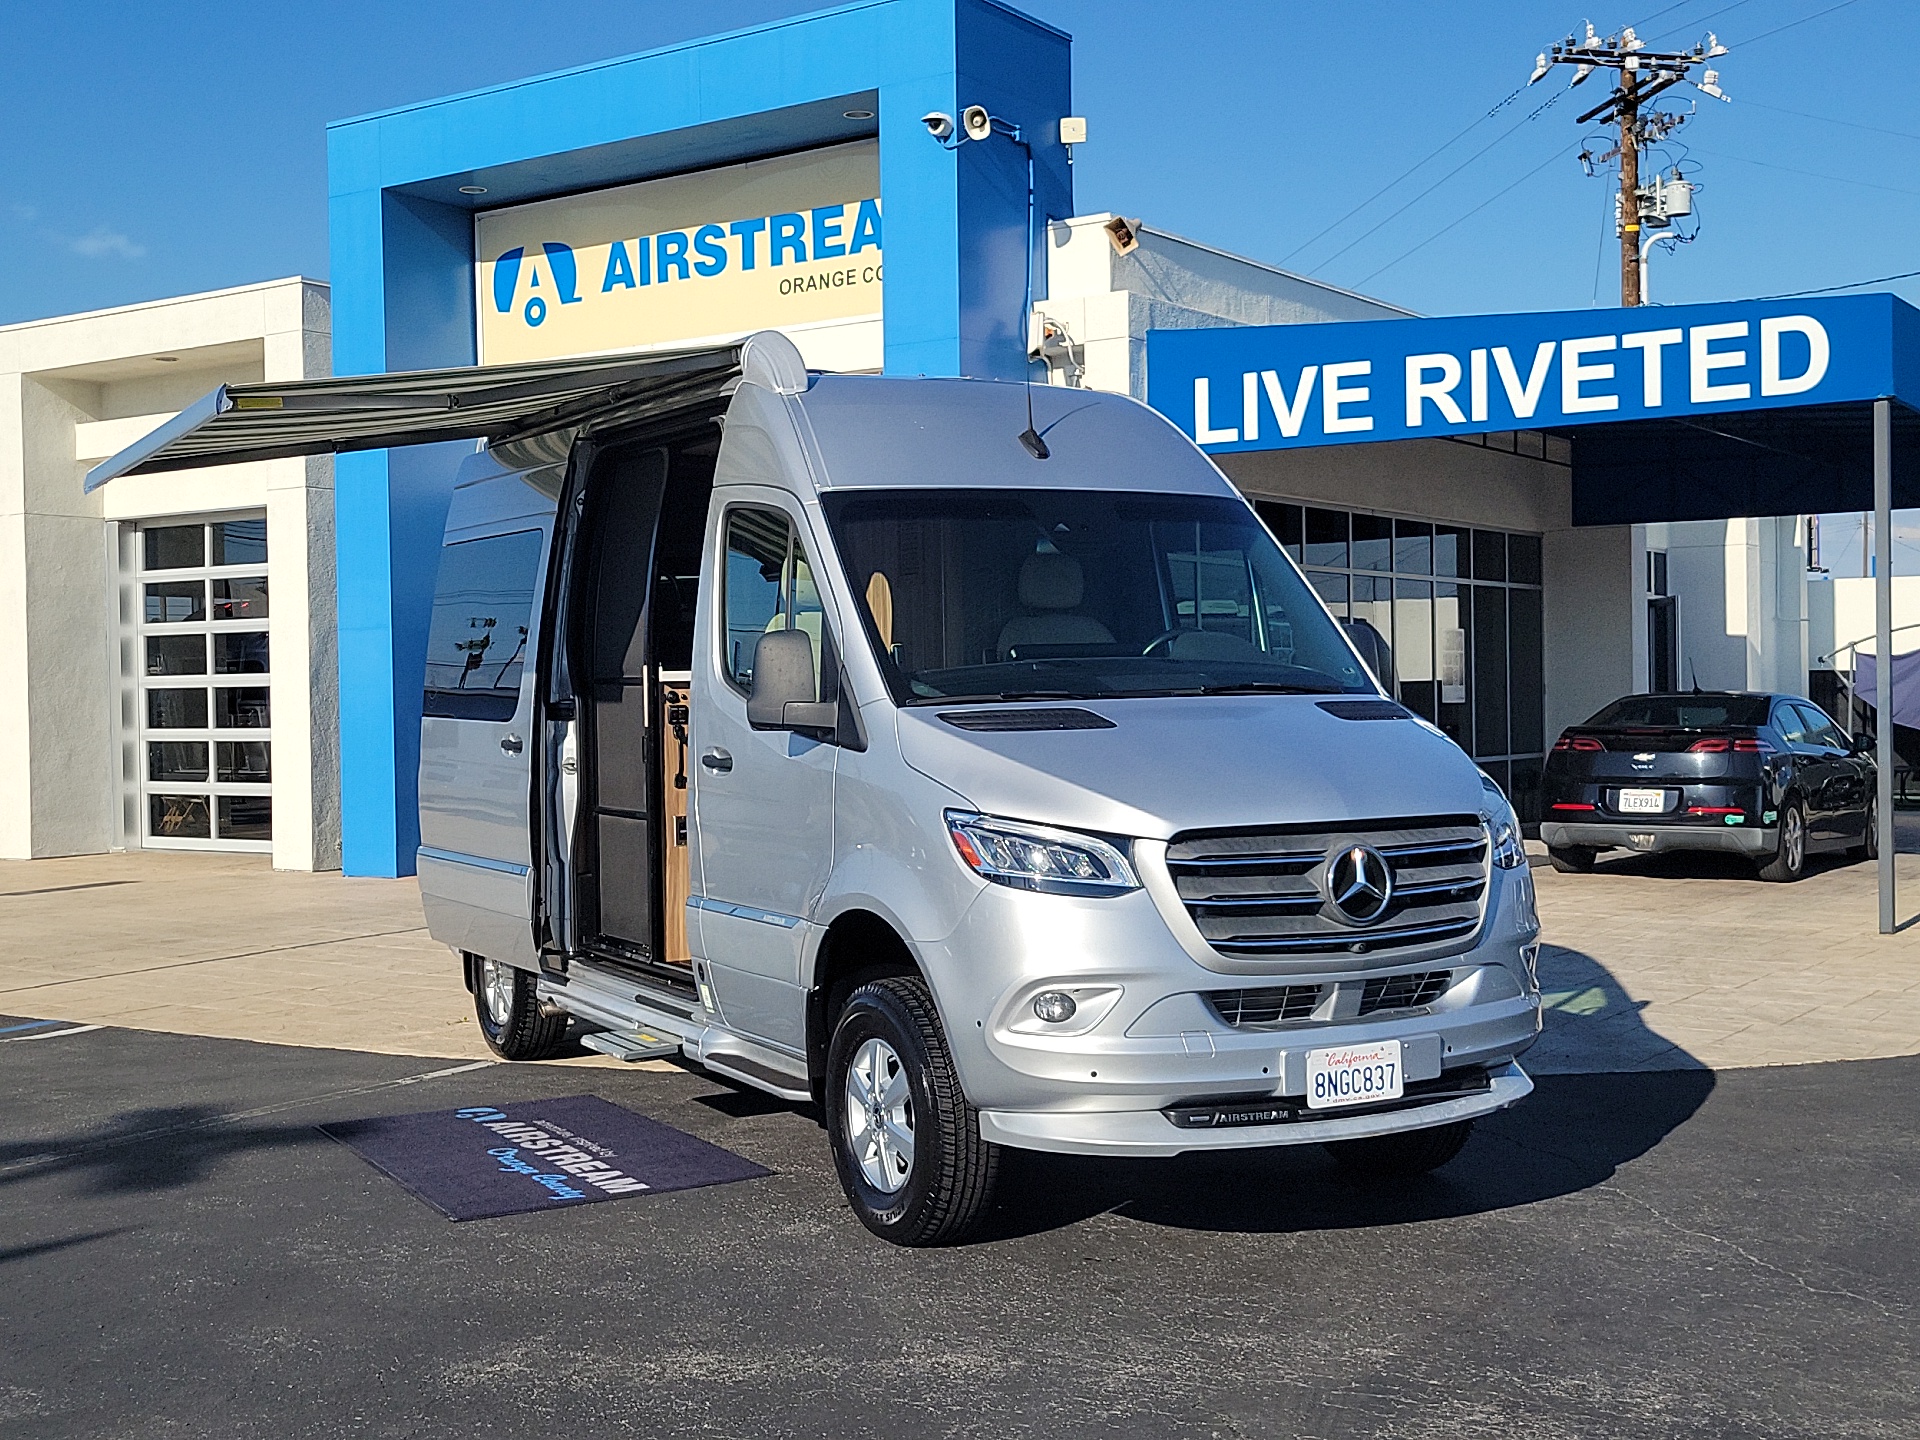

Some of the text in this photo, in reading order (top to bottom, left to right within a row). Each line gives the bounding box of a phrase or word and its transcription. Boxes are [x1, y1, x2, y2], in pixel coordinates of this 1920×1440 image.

[779, 264, 857, 296] ORANGE
[1194, 314, 1831, 445] LIVE RIVETED
[1327, 1051, 1385, 1069] California
[1314, 1062, 1396, 1099] 8NGC837
[1219, 1110, 1289, 1123] AIRSTREAM
[482, 1121, 651, 1195] AIRSTREAM
[487, 1147, 587, 1200] Orange County
